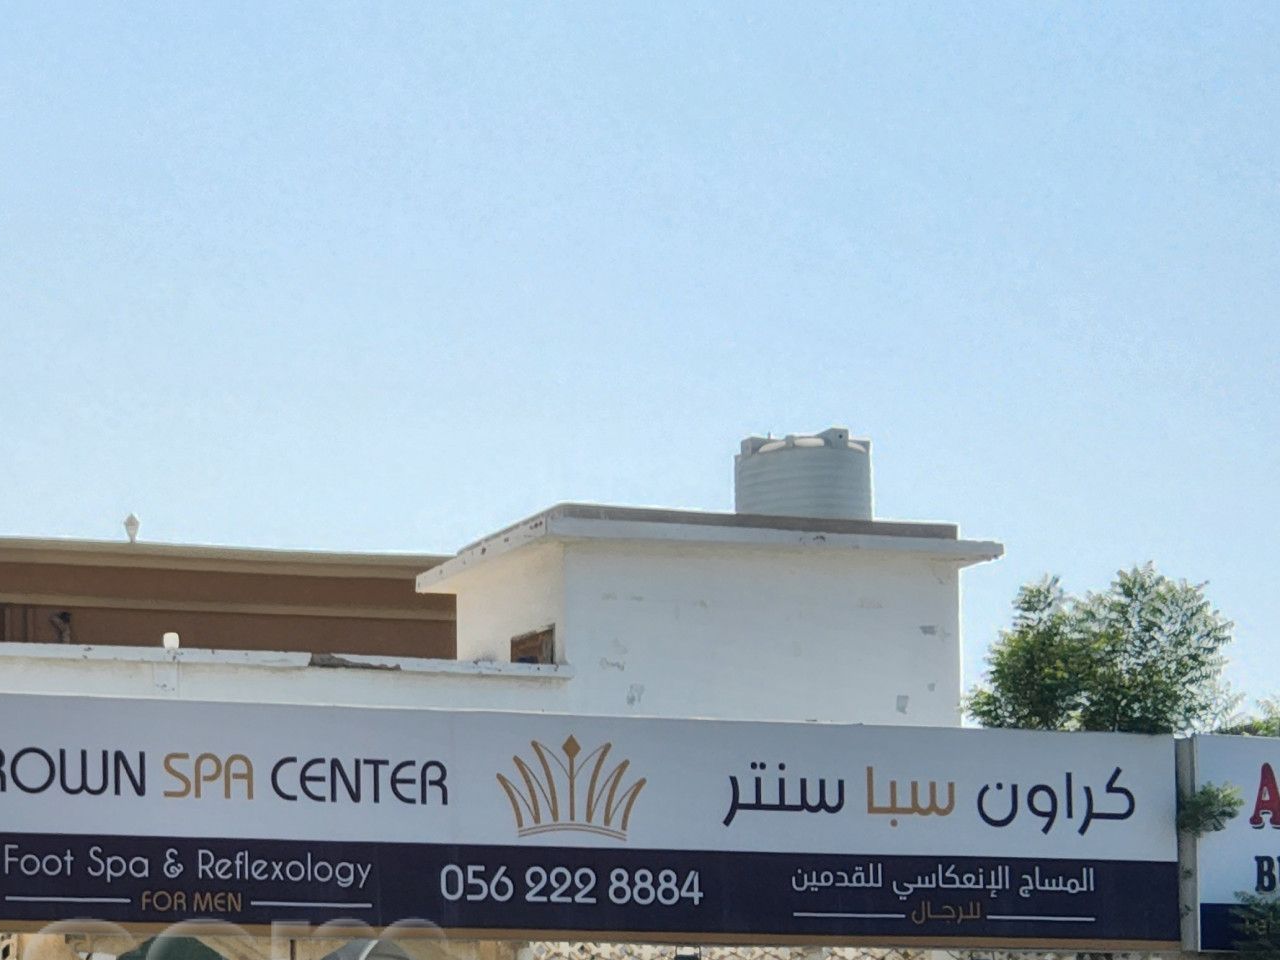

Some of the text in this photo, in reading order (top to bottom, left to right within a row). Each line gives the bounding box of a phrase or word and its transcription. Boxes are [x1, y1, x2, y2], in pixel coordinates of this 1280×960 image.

[163, 752, 255, 800] SPA
[270, 756, 449, 806] CENTER
[722, 761, 1137, 836] كراون سبا سنتر
[4, 843, 372, 889] Foot Spa & Reflexology
[439, 863, 704, 905] 056 222 8884
[791, 863, 1095, 901] المساج الإنعكاسي للقدمين
[141, 890, 242, 913] FOR MEN
[911, 900, 982, 925] للرجال
